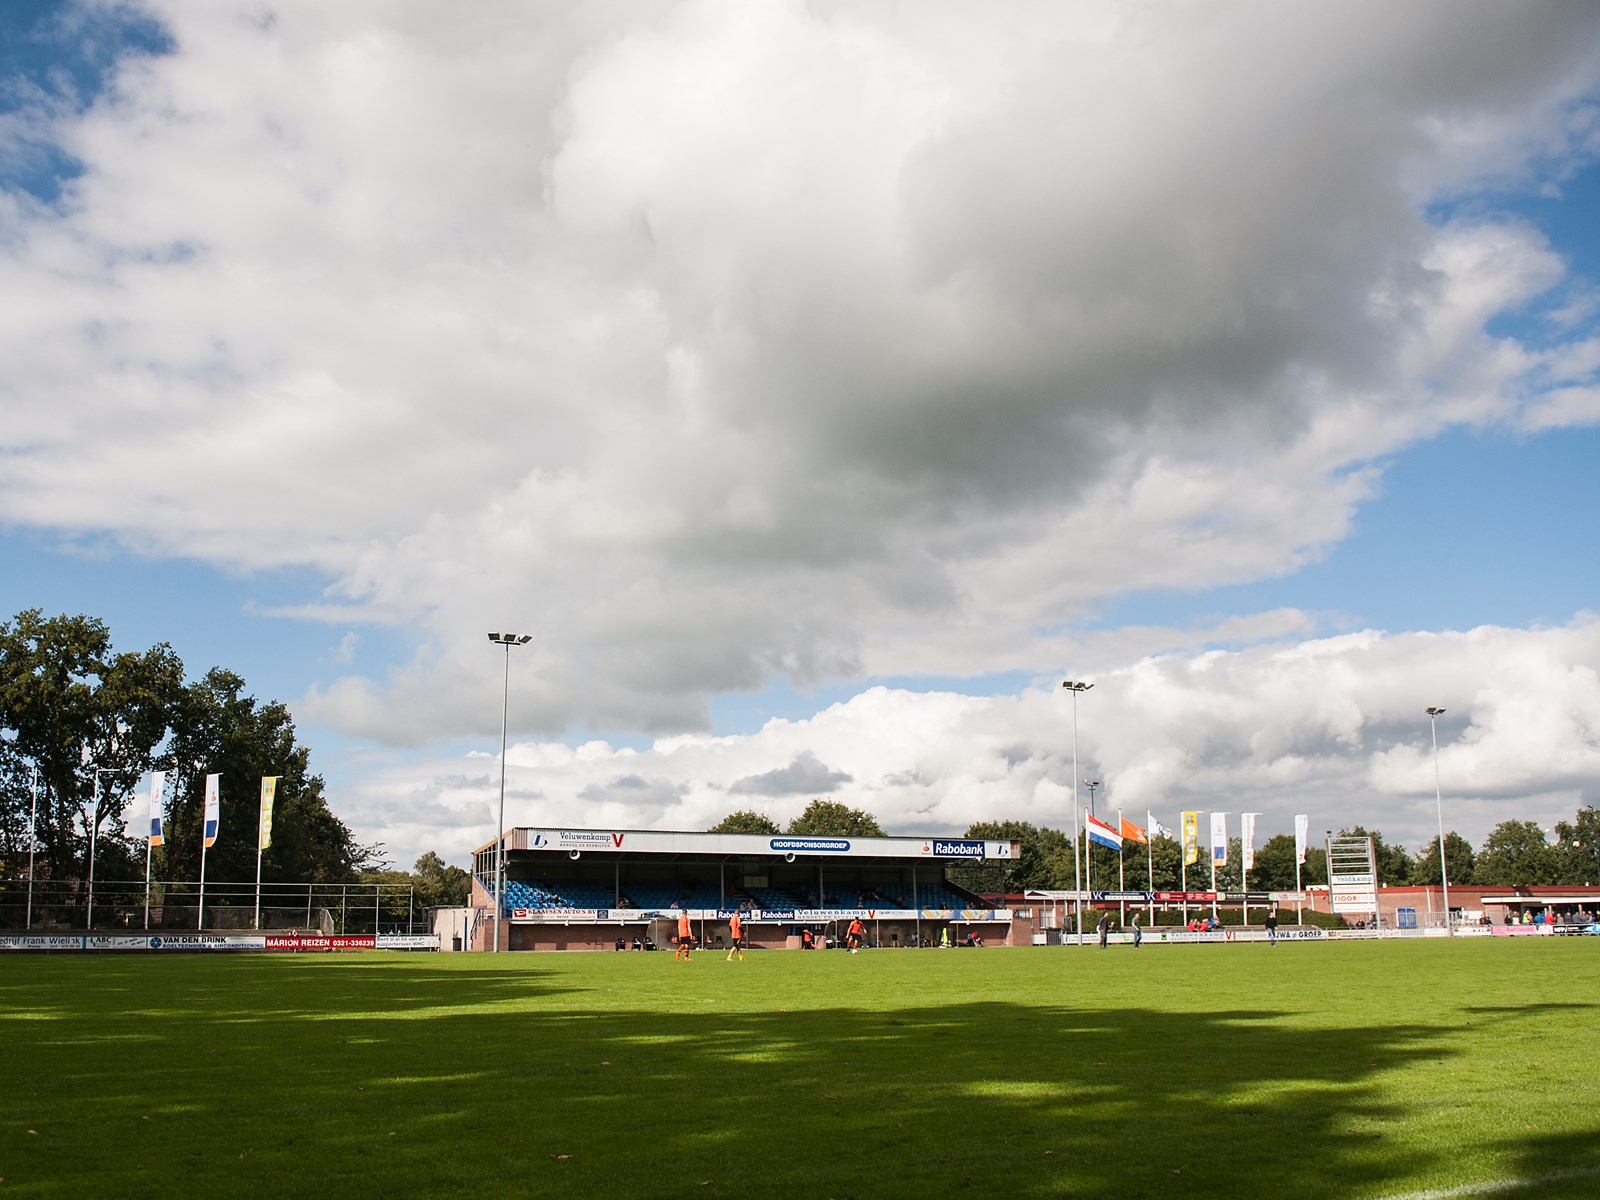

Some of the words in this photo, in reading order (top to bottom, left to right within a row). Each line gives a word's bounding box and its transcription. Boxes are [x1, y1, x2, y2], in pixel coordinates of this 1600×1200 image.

[560, 832, 611, 842] Veluwenkamp
[773, 841, 847, 849] HOOFDSPONSORGROEP
[935, 842, 984, 855] Rabobank
[718, 910, 750, 919] Raboank
[762, 911, 794, 919] Rabobank
